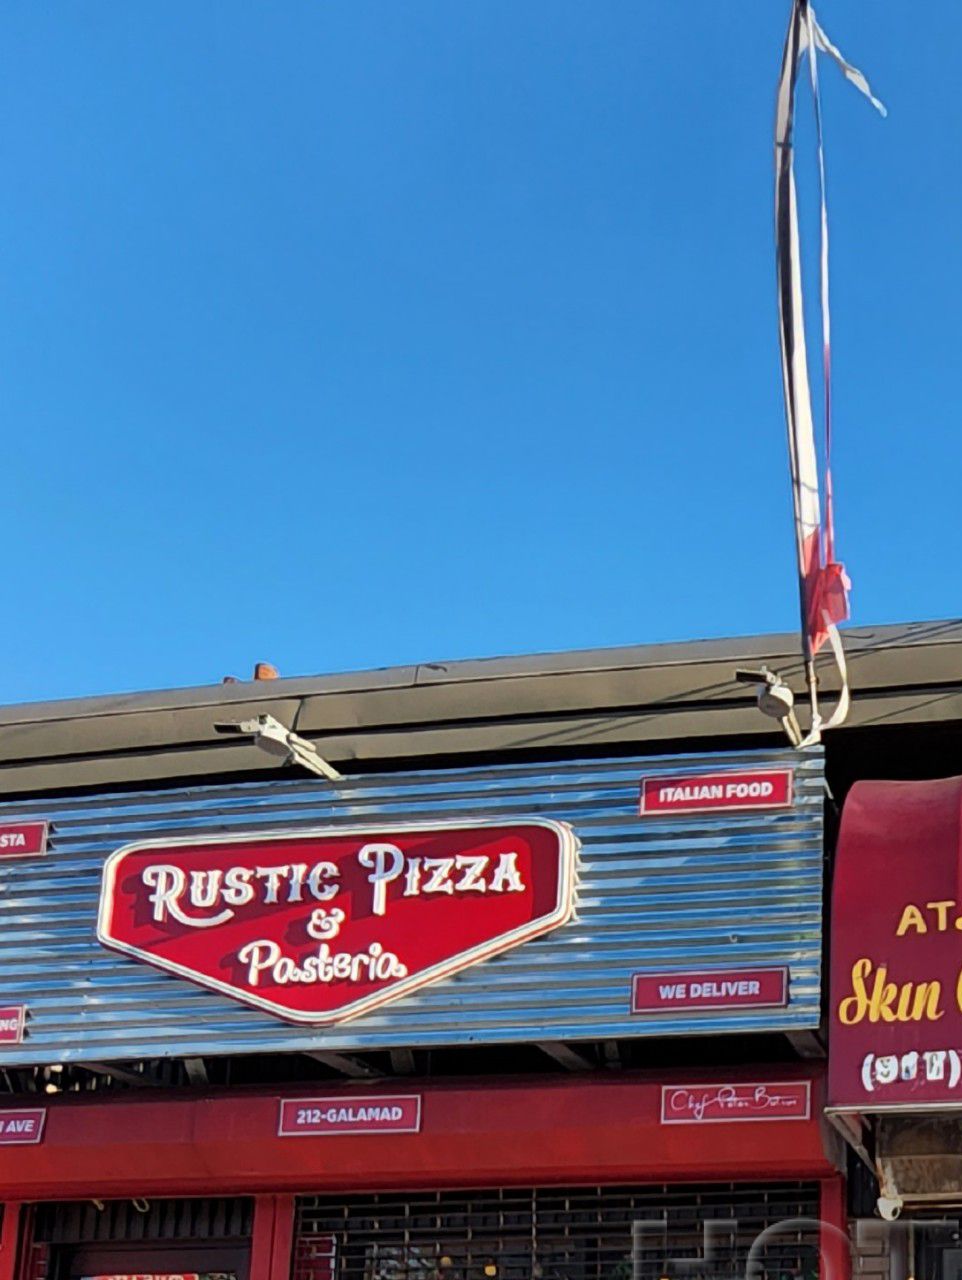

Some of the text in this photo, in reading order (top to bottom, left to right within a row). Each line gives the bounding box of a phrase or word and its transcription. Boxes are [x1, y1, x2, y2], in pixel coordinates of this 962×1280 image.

[658, 781, 774, 803] ITALIAN FOOD
[142, 842, 526, 928] RUSTIC PIZZA
[306, 907, 345, 940] &
[238, 939, 408, 987] Pasteria
[659, 980, 761, 1000] WE DELIVER
[838, 957, 945, 1026] Skin
[5, 1119, 35, 1133] AVE
[296, 1106, 403, 1125] 212-GALAMAD
